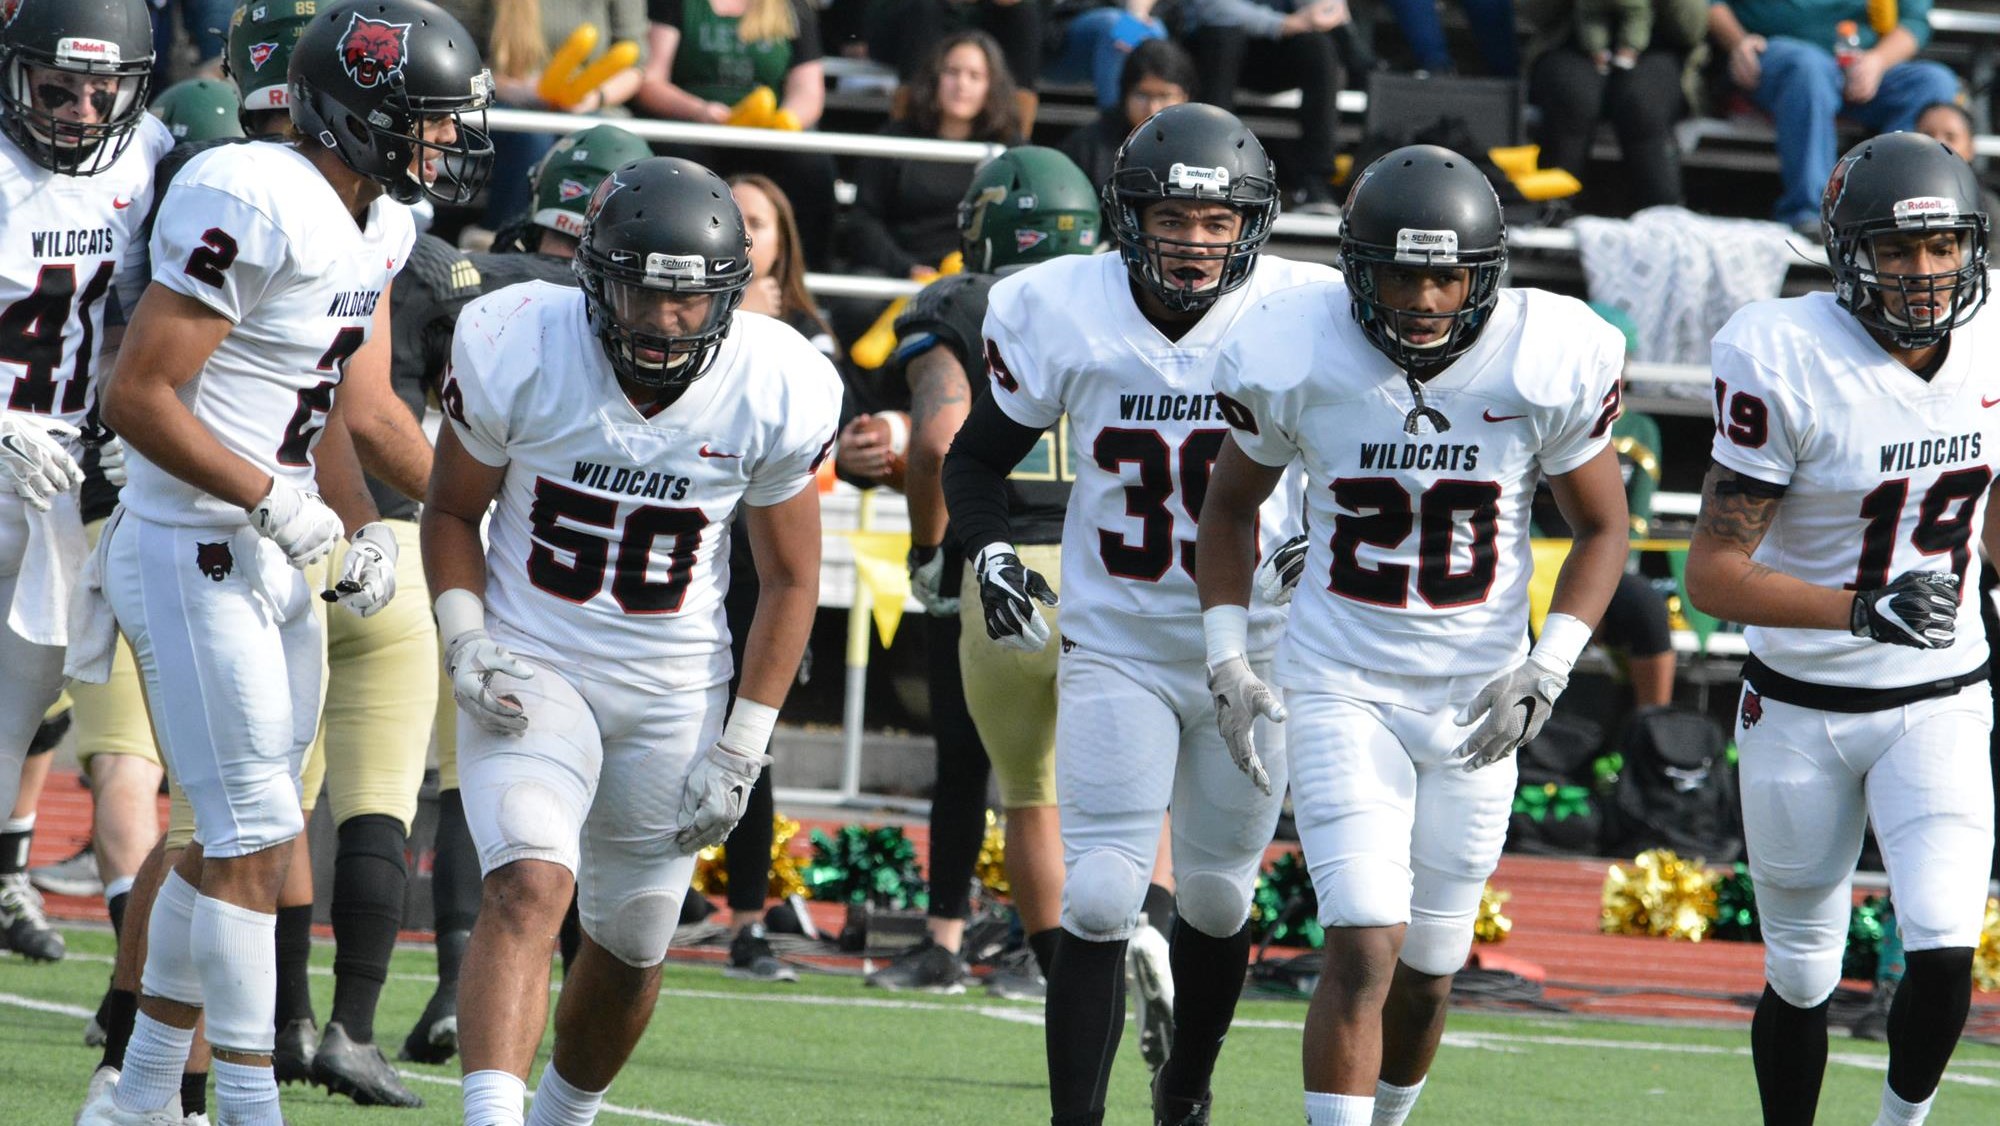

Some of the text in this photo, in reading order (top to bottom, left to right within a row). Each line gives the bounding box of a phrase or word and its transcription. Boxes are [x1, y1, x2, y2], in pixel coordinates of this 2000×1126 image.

[72, 41, 105, 53] Riddell
[1907, 201, 1942, 211] Riddell
[32, 228, 113, 258] WILDCATS
[184, 227, 238, 289] 2
[1411, 233, 1444, 243] schutt
[660, 259, 692, 269] schutt
[0, 260, 116, 415] 41
[277, 326, 364, 467] 2
[1715, 376, 1768, 449] 19
[1360, 443, 1480, 471] WILDCATS
[1881, 432, 1982, 473] WILDCATS
[571, 461, 691, 501] WILDCATS
[527, 476, 710, 615] 50
[1327, 477, 1503, 610] 20
[1843, 464, 1993, 607] 19
